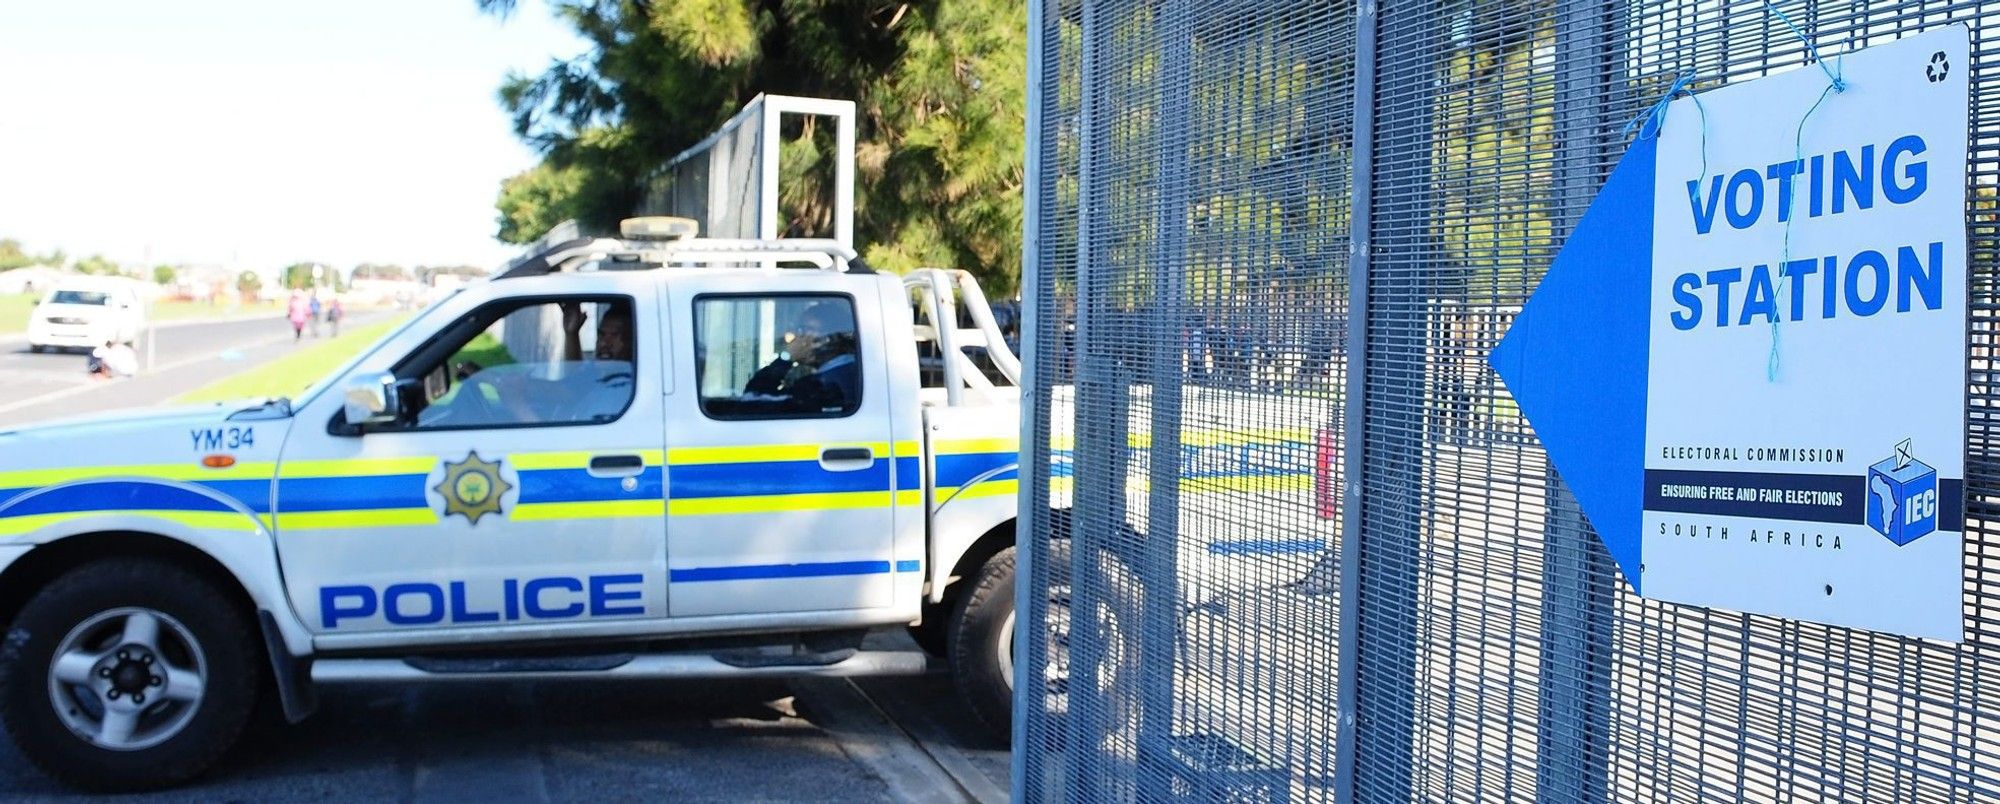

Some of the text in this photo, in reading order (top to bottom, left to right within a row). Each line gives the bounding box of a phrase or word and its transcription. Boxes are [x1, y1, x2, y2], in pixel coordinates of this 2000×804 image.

[1686, 135, 1928, 235] VOTING
[1670, 242, 1943, 331] STATION
[1662, 446, 1844, 463] ELECTORAL COMMISSION
[1660, 484, 1843, 507] ENSURING FREE AND FAIR ELECTIONS
[1904, 488, 1935, 526] IEC
[1660, 522, 1842, 550] SOUTH AFRICA
[319, 573, 646, 629] POLICE
